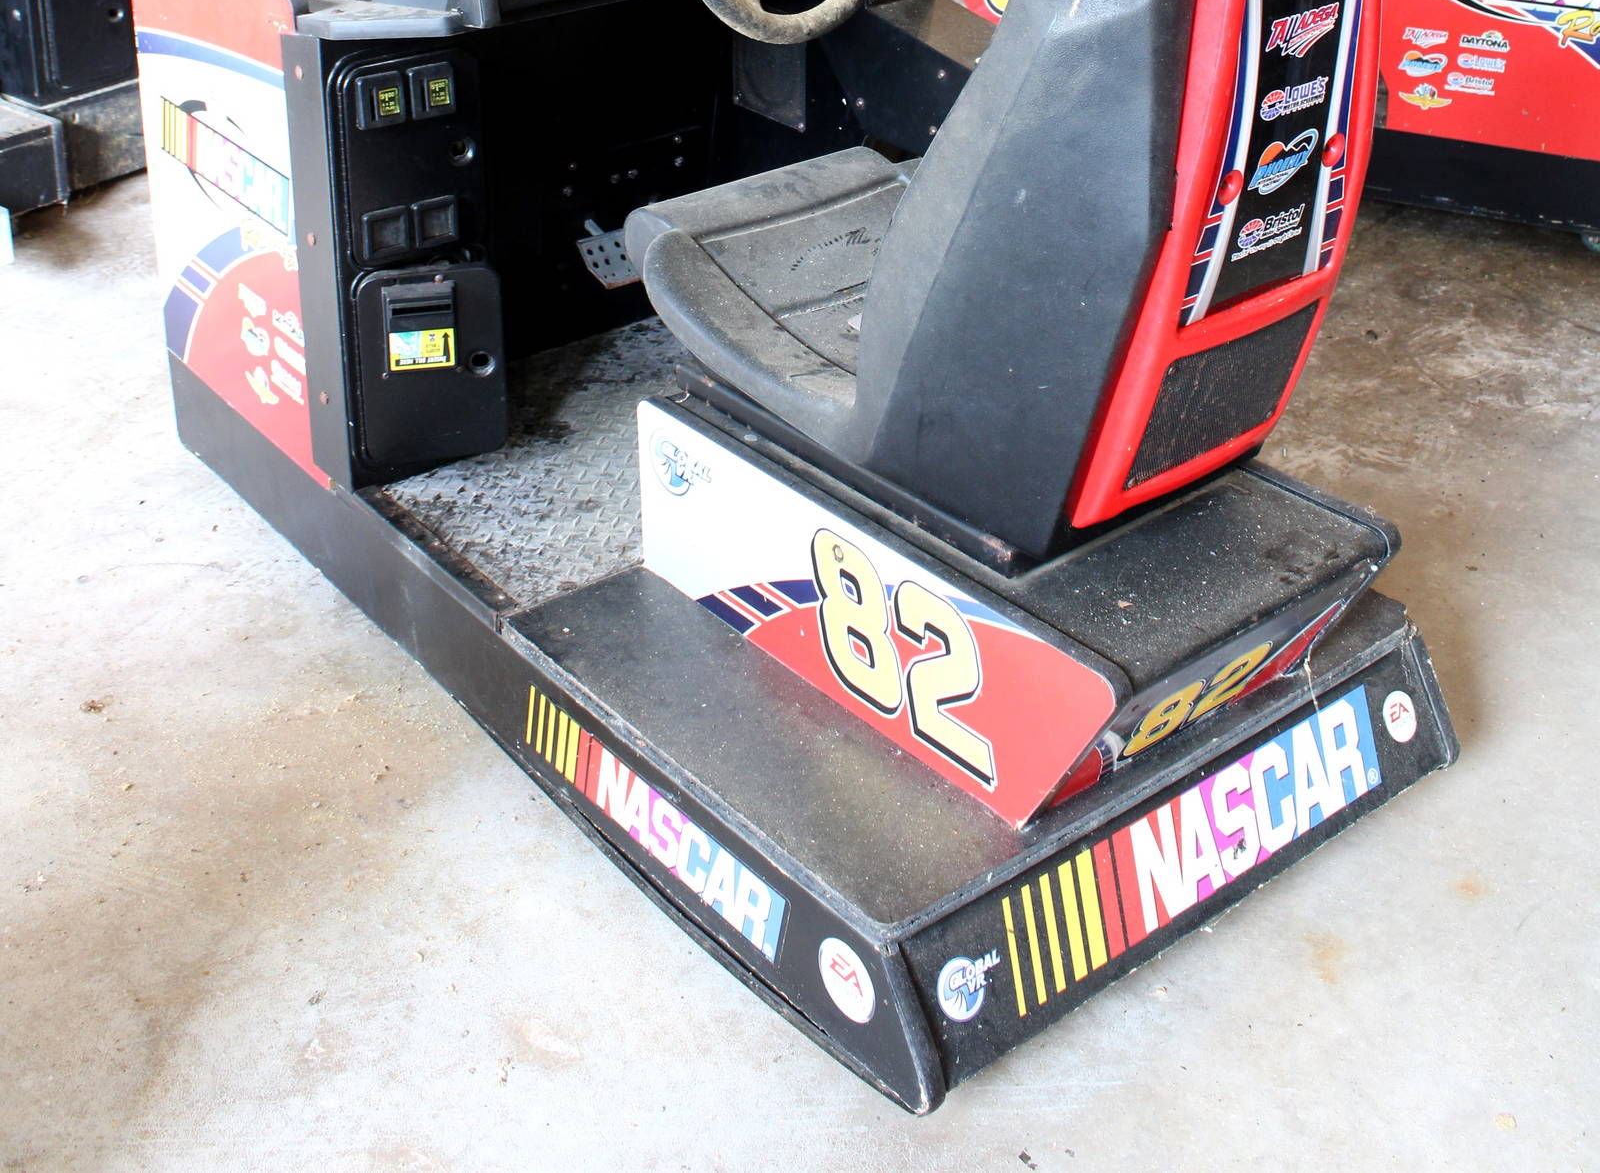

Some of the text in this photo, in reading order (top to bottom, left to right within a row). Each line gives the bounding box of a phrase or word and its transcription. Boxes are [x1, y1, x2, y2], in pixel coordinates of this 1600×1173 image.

[1461, 35, 1509, 49] DAYTONA
[1249, 149, 1308, 188] PHOENIX
[1264, 203, 1305, 231] Bristol
[810, 527, 997, 789] 82
[1117, 640, 1273, 762] 82
[1390, 701, 1409, 723] EA
[1129, 698, 1369, 936] NASCAR
[595, 747, 773, 953] NASCAR
[829, 951, 864, 998] EA
[949, 947, 1001, 992] GLOBAL
[966, 972, 988, 995] VR
